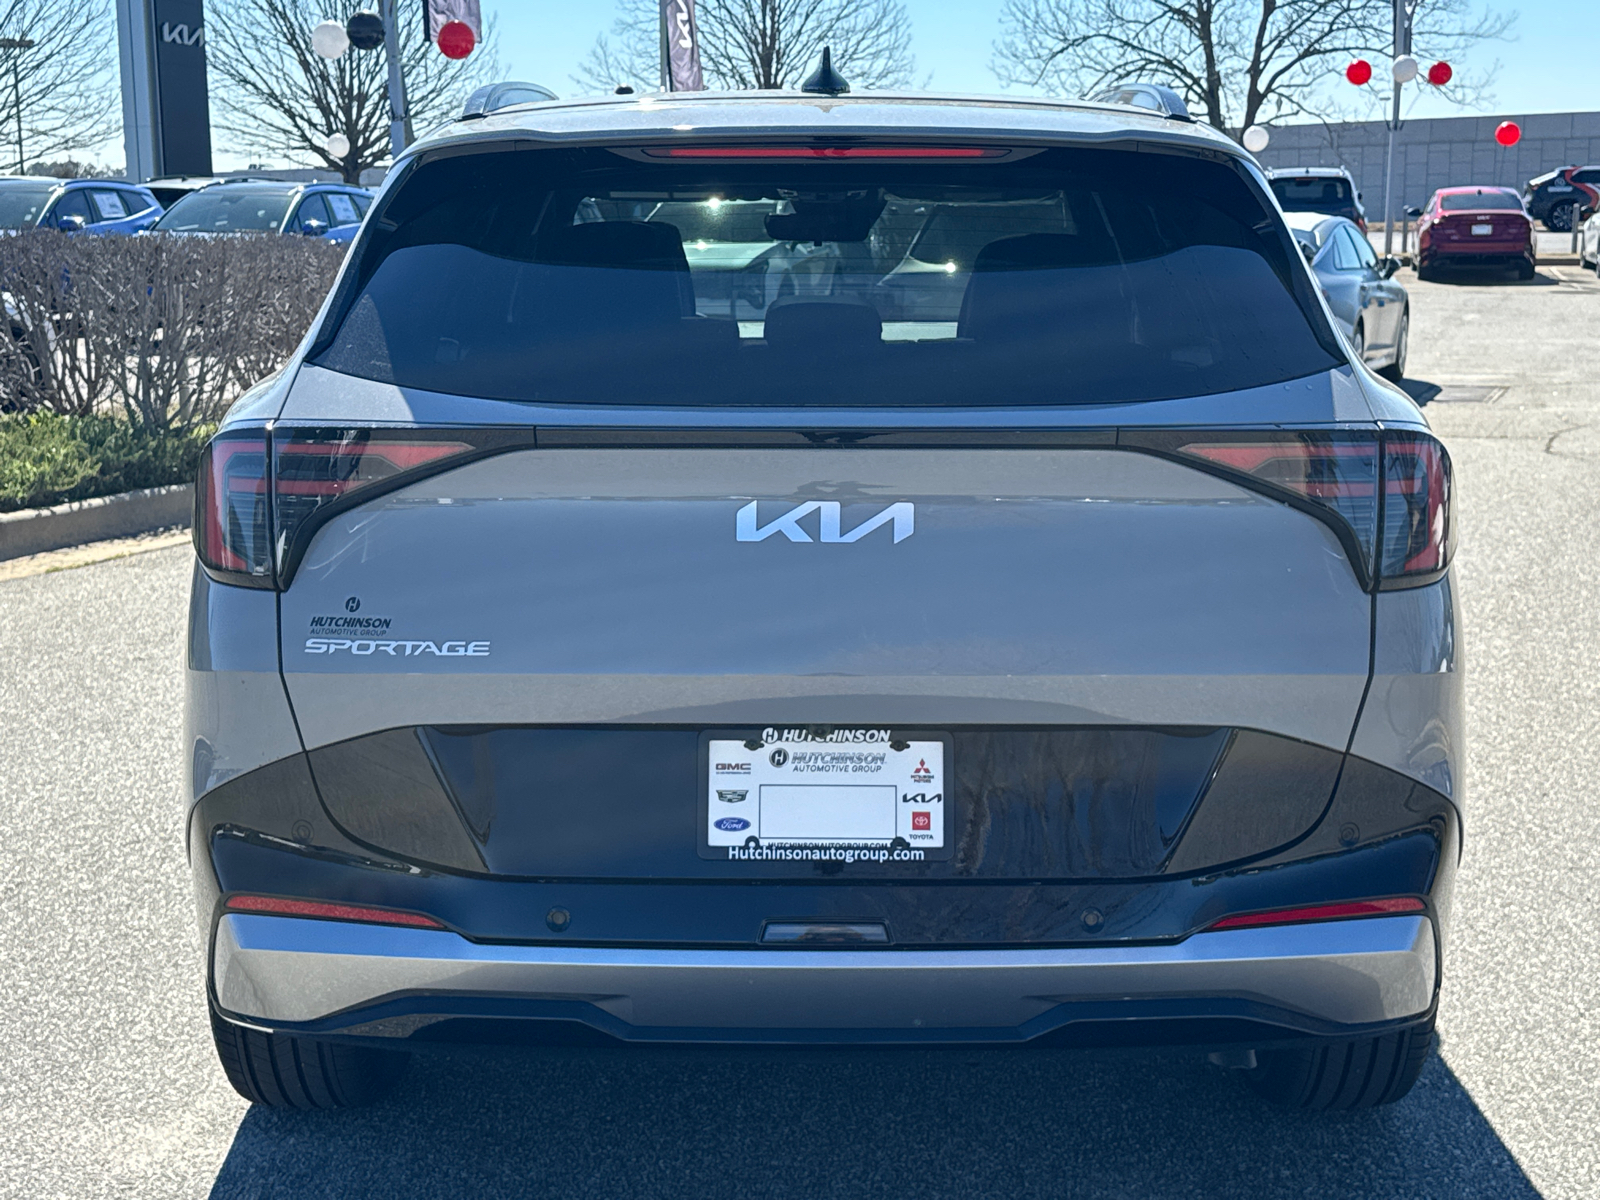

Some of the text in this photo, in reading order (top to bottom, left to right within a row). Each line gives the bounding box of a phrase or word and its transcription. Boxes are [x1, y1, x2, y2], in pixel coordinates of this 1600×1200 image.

[736, 500, 914, 544] KIA
[310, 616, 392, 629] HUTCHINSON
[310, 628, 387, 637] AUTOMOTIVE GROUP
[304, 638, 491, 656] SPORTAGE
[781, 729, 891, 743] HUHINSON
[791, 752, 887, 765] HUTCHINSON
[715, 763, 752, 771] GMC
[793, 765, 882, 773] AUTOMOTIVE GROUP
[902, 793, 942, 803] KIA
[721, 818, 744, 829] Ford
[728, 846, 925, 863] Hutchinsonautogroup.com
